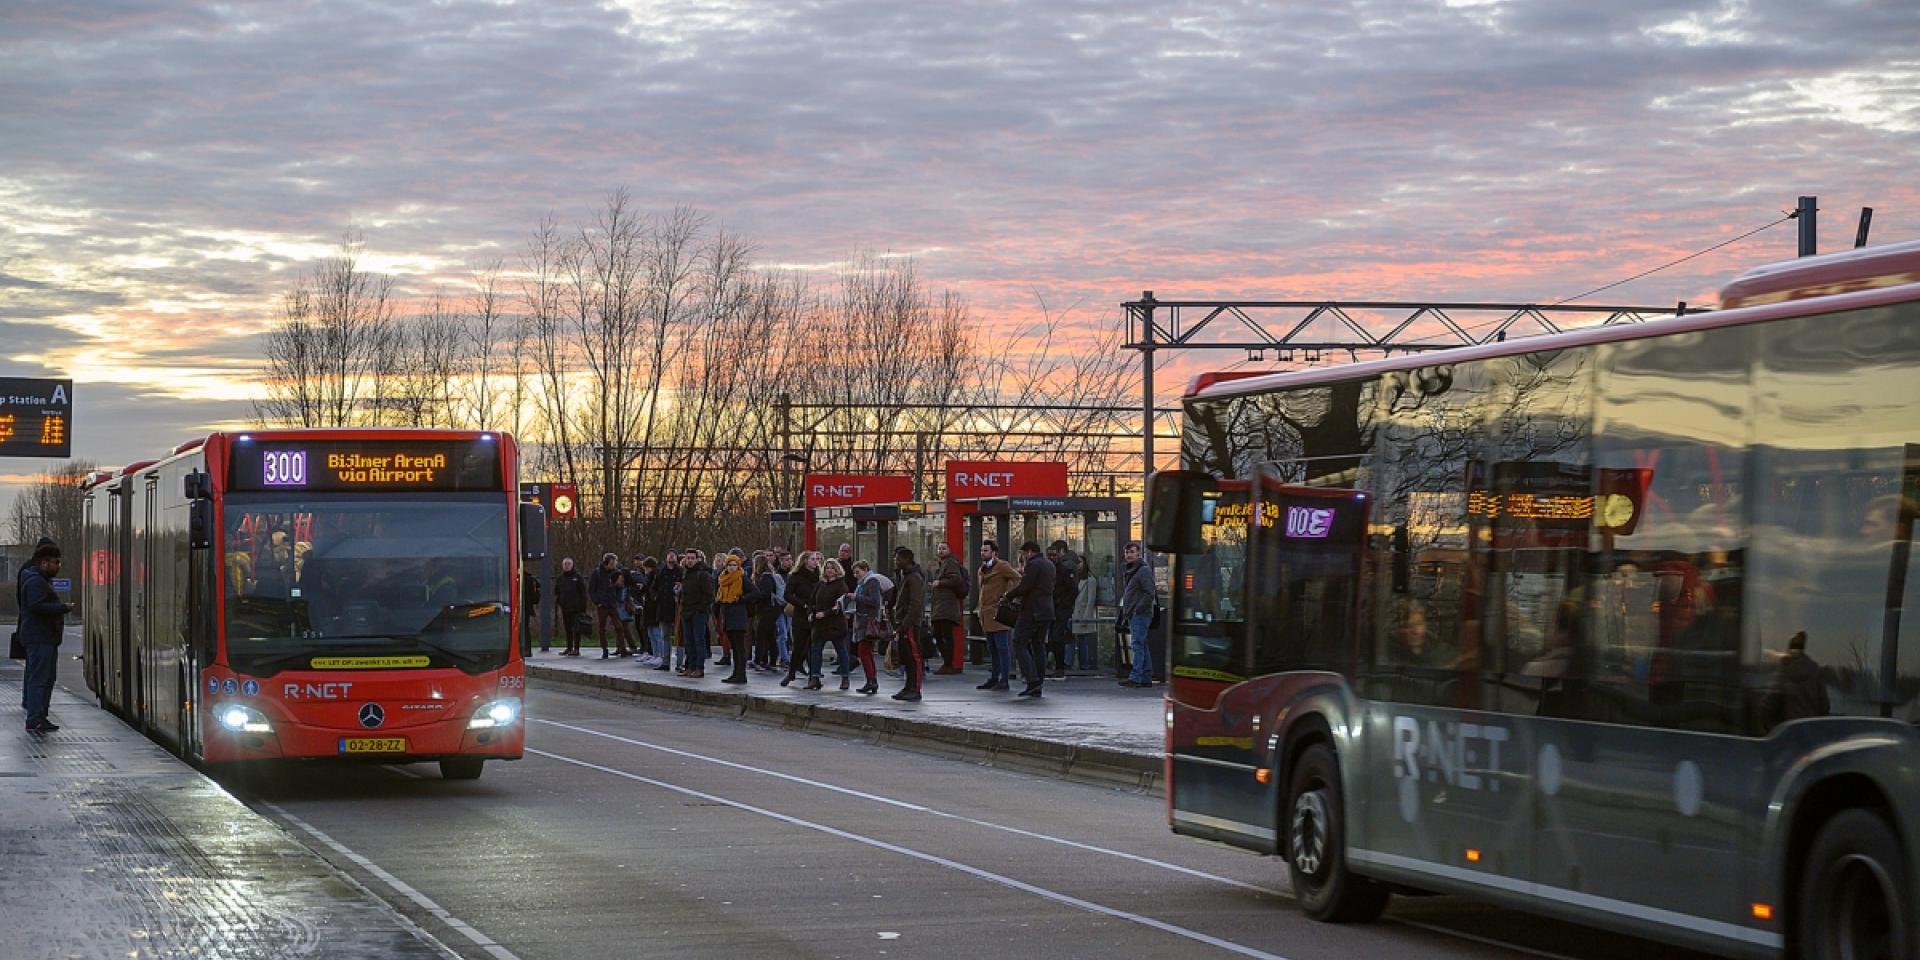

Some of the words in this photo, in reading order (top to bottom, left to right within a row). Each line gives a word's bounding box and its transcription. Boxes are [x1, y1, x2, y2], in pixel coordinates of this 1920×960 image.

[9, 396, 47, 404] Station
[50, 384, 68, 404] A
[328, 454, 392, 467] Bijlmer
[394, 454, 445, 467] ArenA
[266, 453, 302, 482] 300
[338, 468, 366, 481] via
[369, 468, 433, 481] Airport
[350, 740, 400, 751] 02-28-ZZ
